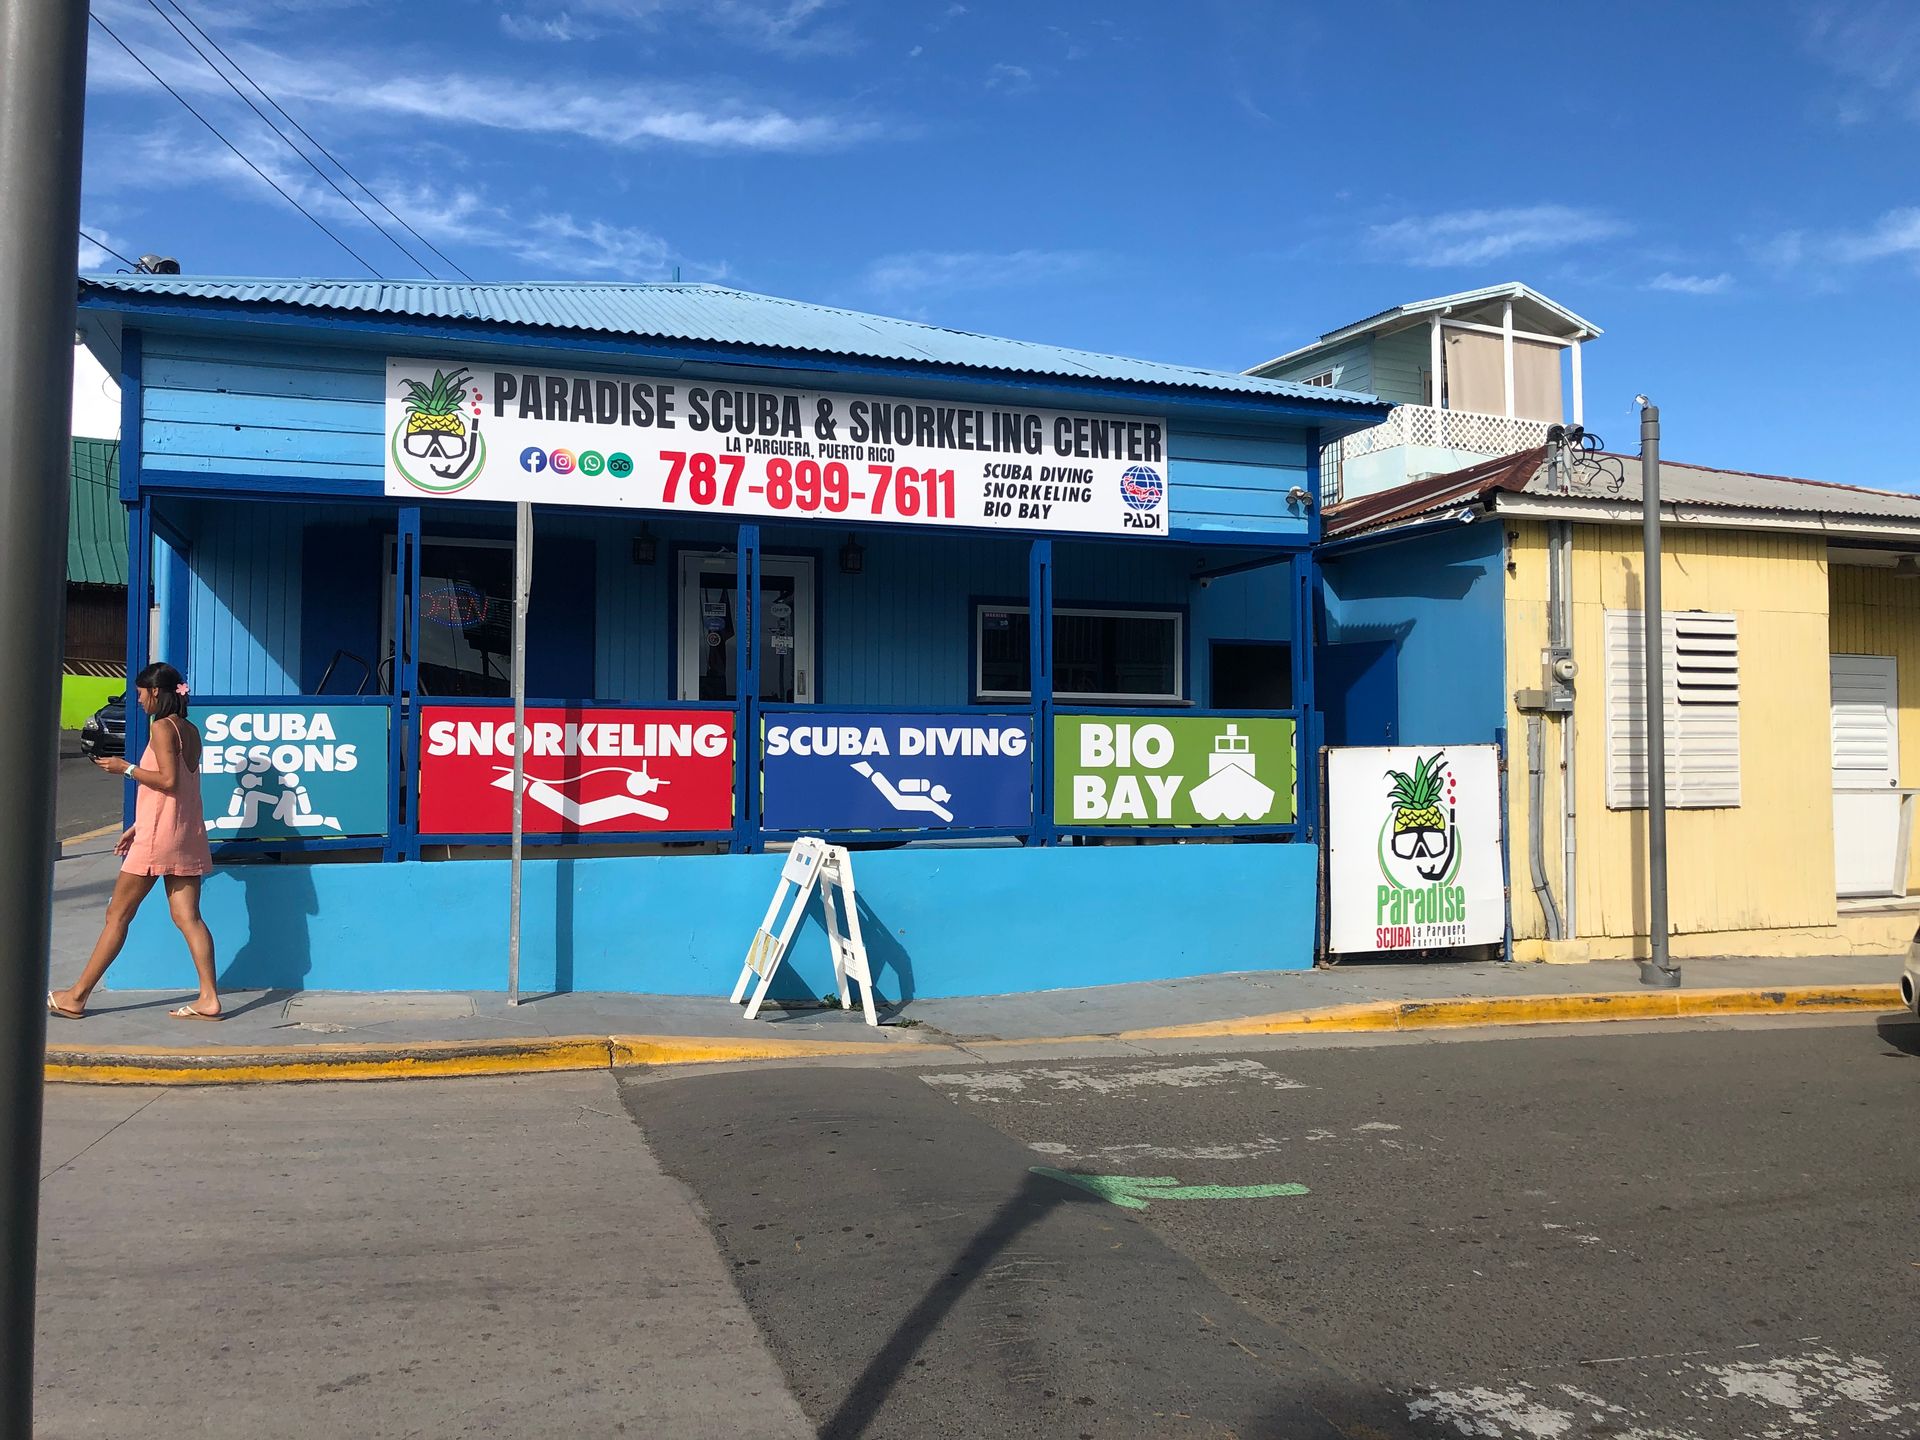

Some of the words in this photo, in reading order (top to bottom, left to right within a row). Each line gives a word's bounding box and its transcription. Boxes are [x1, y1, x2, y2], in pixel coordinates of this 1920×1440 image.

[493, 372, 676, 429] PARADISE
[688, 388, 802, 438] SCUBA
[814, 398, 838, 441] &
[849, 401, 1042, 455] SNORKELING
[1053, 416, 1162, 463] CENTER
[726, 437, 742, 453] LA
[745, 438, 814, 460] PARGUERA,
[819, 443, 865, 461] PUERTO
[868, 447, 895, 463] RICO
[659, 450, 955, 518] 787-899-7611
[983, 463, 1033, 482] SCUBA
[1040, 466, 1094, 485] DIVING
[984, 482, 1092, 503] SNORKELING
[984, 501, 1011, 518] BIO
[1018, 503, 1052, 520] BAY
[1123, 512, 1160, 529] PADI
[204, 713, 337, 742] SCUBA
[427, 720, 728, 758] SNORKELING
[766, 726, 890, 756] SCUBA
[899, 727, 1027, 757] DIVING
[198, 744, 358, 777] ESSONS
[1080, 723, 1175, 769] BIO
[1073, 775, 1185, 820] BAY
[1377, 883, 1466, 926] Paradise
[1376, 926, 1411, 949] SCUBA
[1412, 926, 1422, 938] La
[1426, 924, 1466, 938] Parguera
